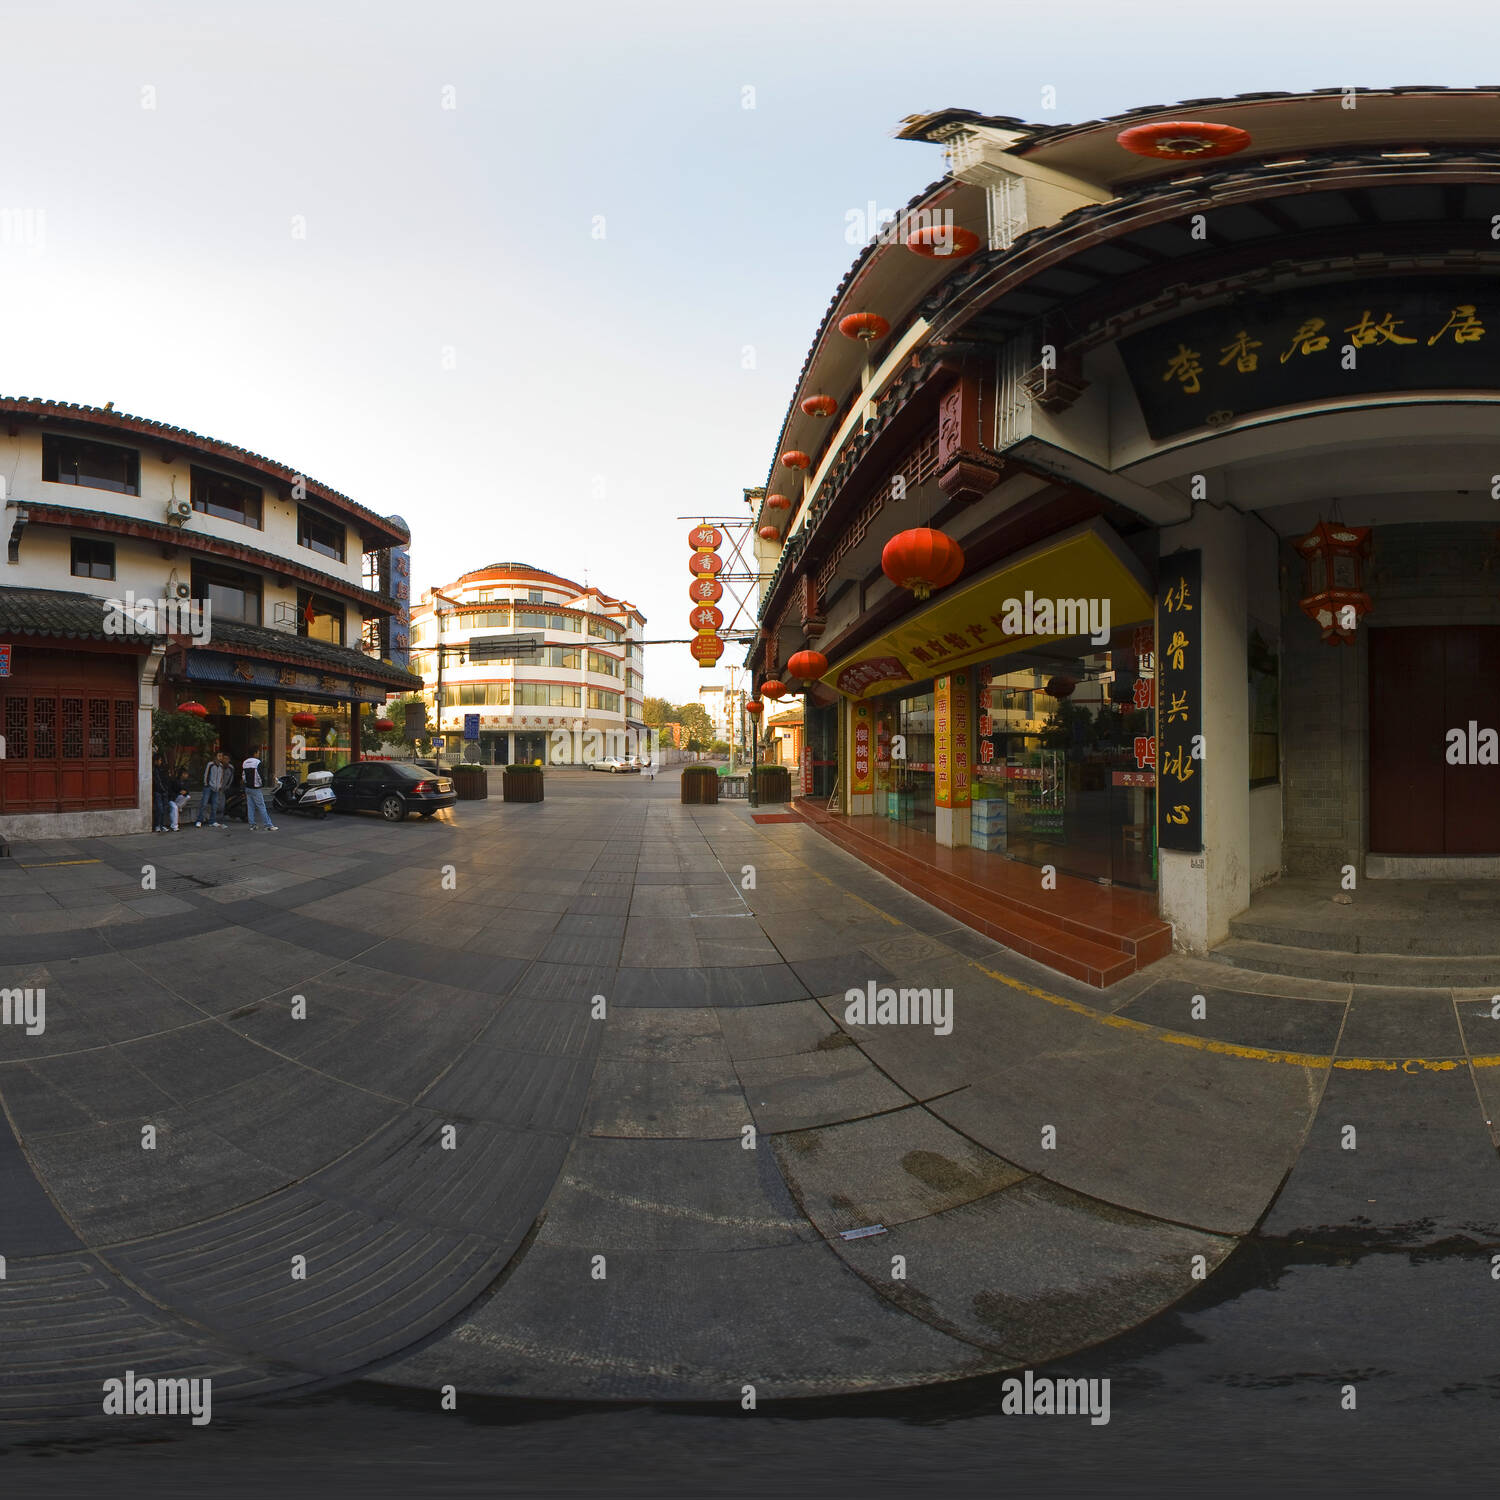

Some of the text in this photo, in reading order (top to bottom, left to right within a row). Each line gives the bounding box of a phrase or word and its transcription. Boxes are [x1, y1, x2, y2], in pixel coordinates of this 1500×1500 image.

[856, 729, 868, 773] 樱桃鸭
[938, 699, 947, 787] 南京土特产
